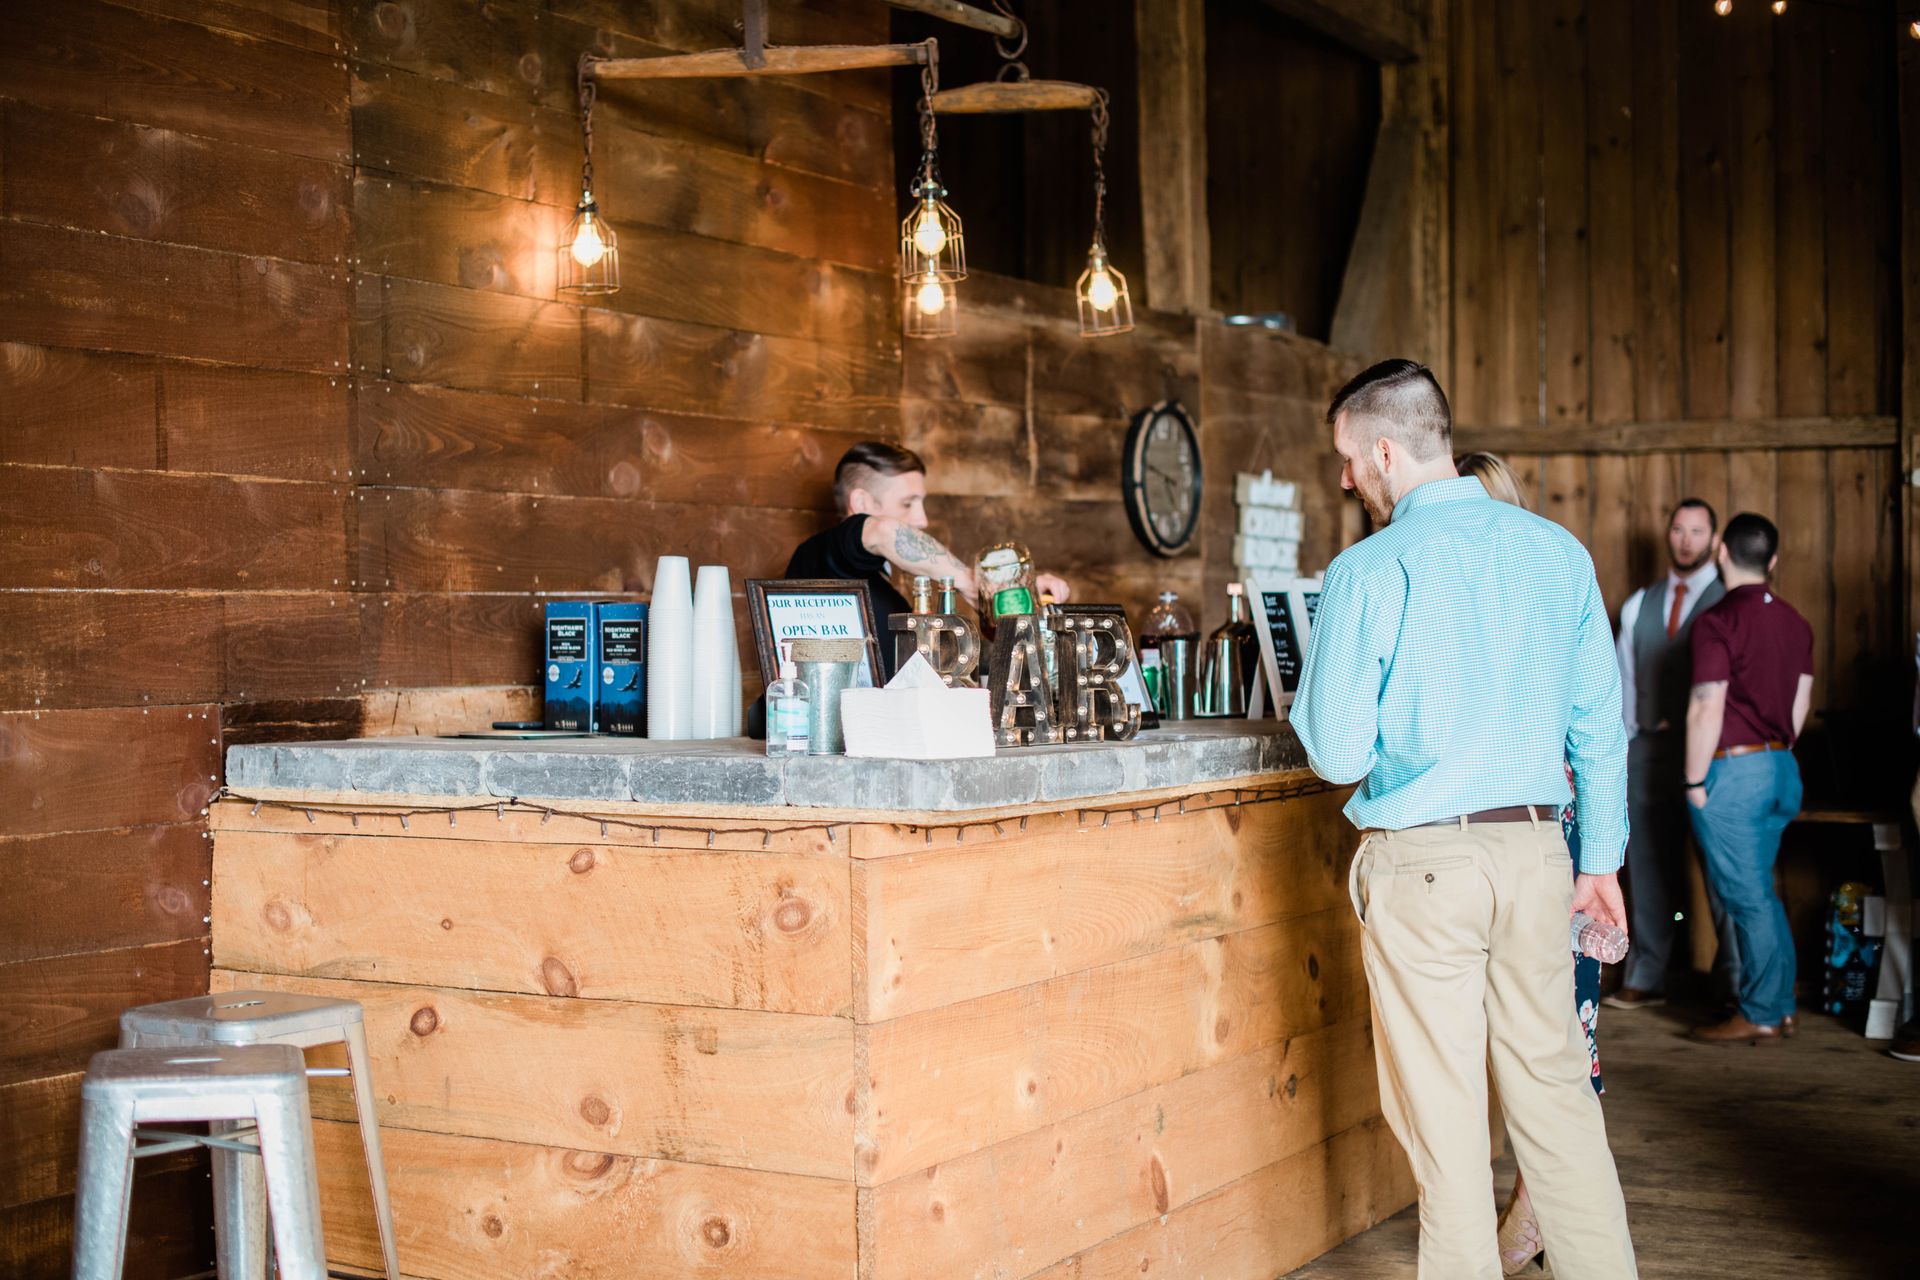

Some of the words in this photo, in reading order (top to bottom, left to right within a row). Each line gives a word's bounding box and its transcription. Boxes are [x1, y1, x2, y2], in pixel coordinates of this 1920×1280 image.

[794, 598, 853, 608] RECEPTION
[782, 625, 817, 636] OPEN
[821, 624, 849, 635] BAR
